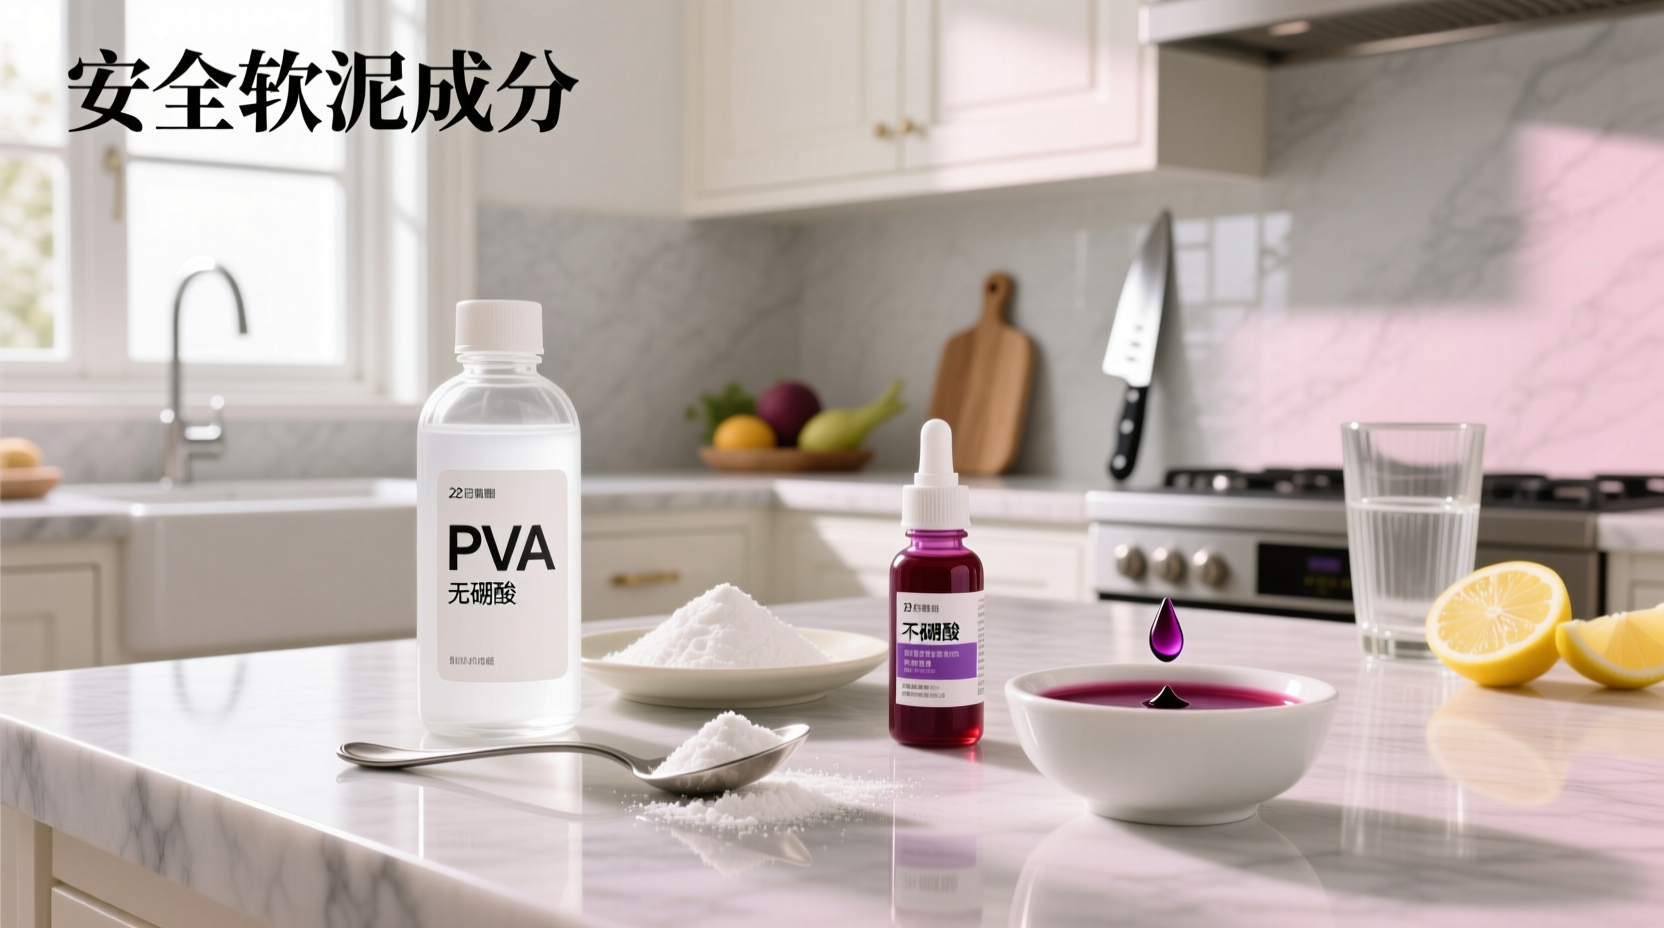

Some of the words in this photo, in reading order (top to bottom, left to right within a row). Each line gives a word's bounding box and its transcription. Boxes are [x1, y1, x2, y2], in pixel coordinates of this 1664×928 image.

[449, 525, 556, 571] PVA
[448, 581, 517, 606] 无硼酸
